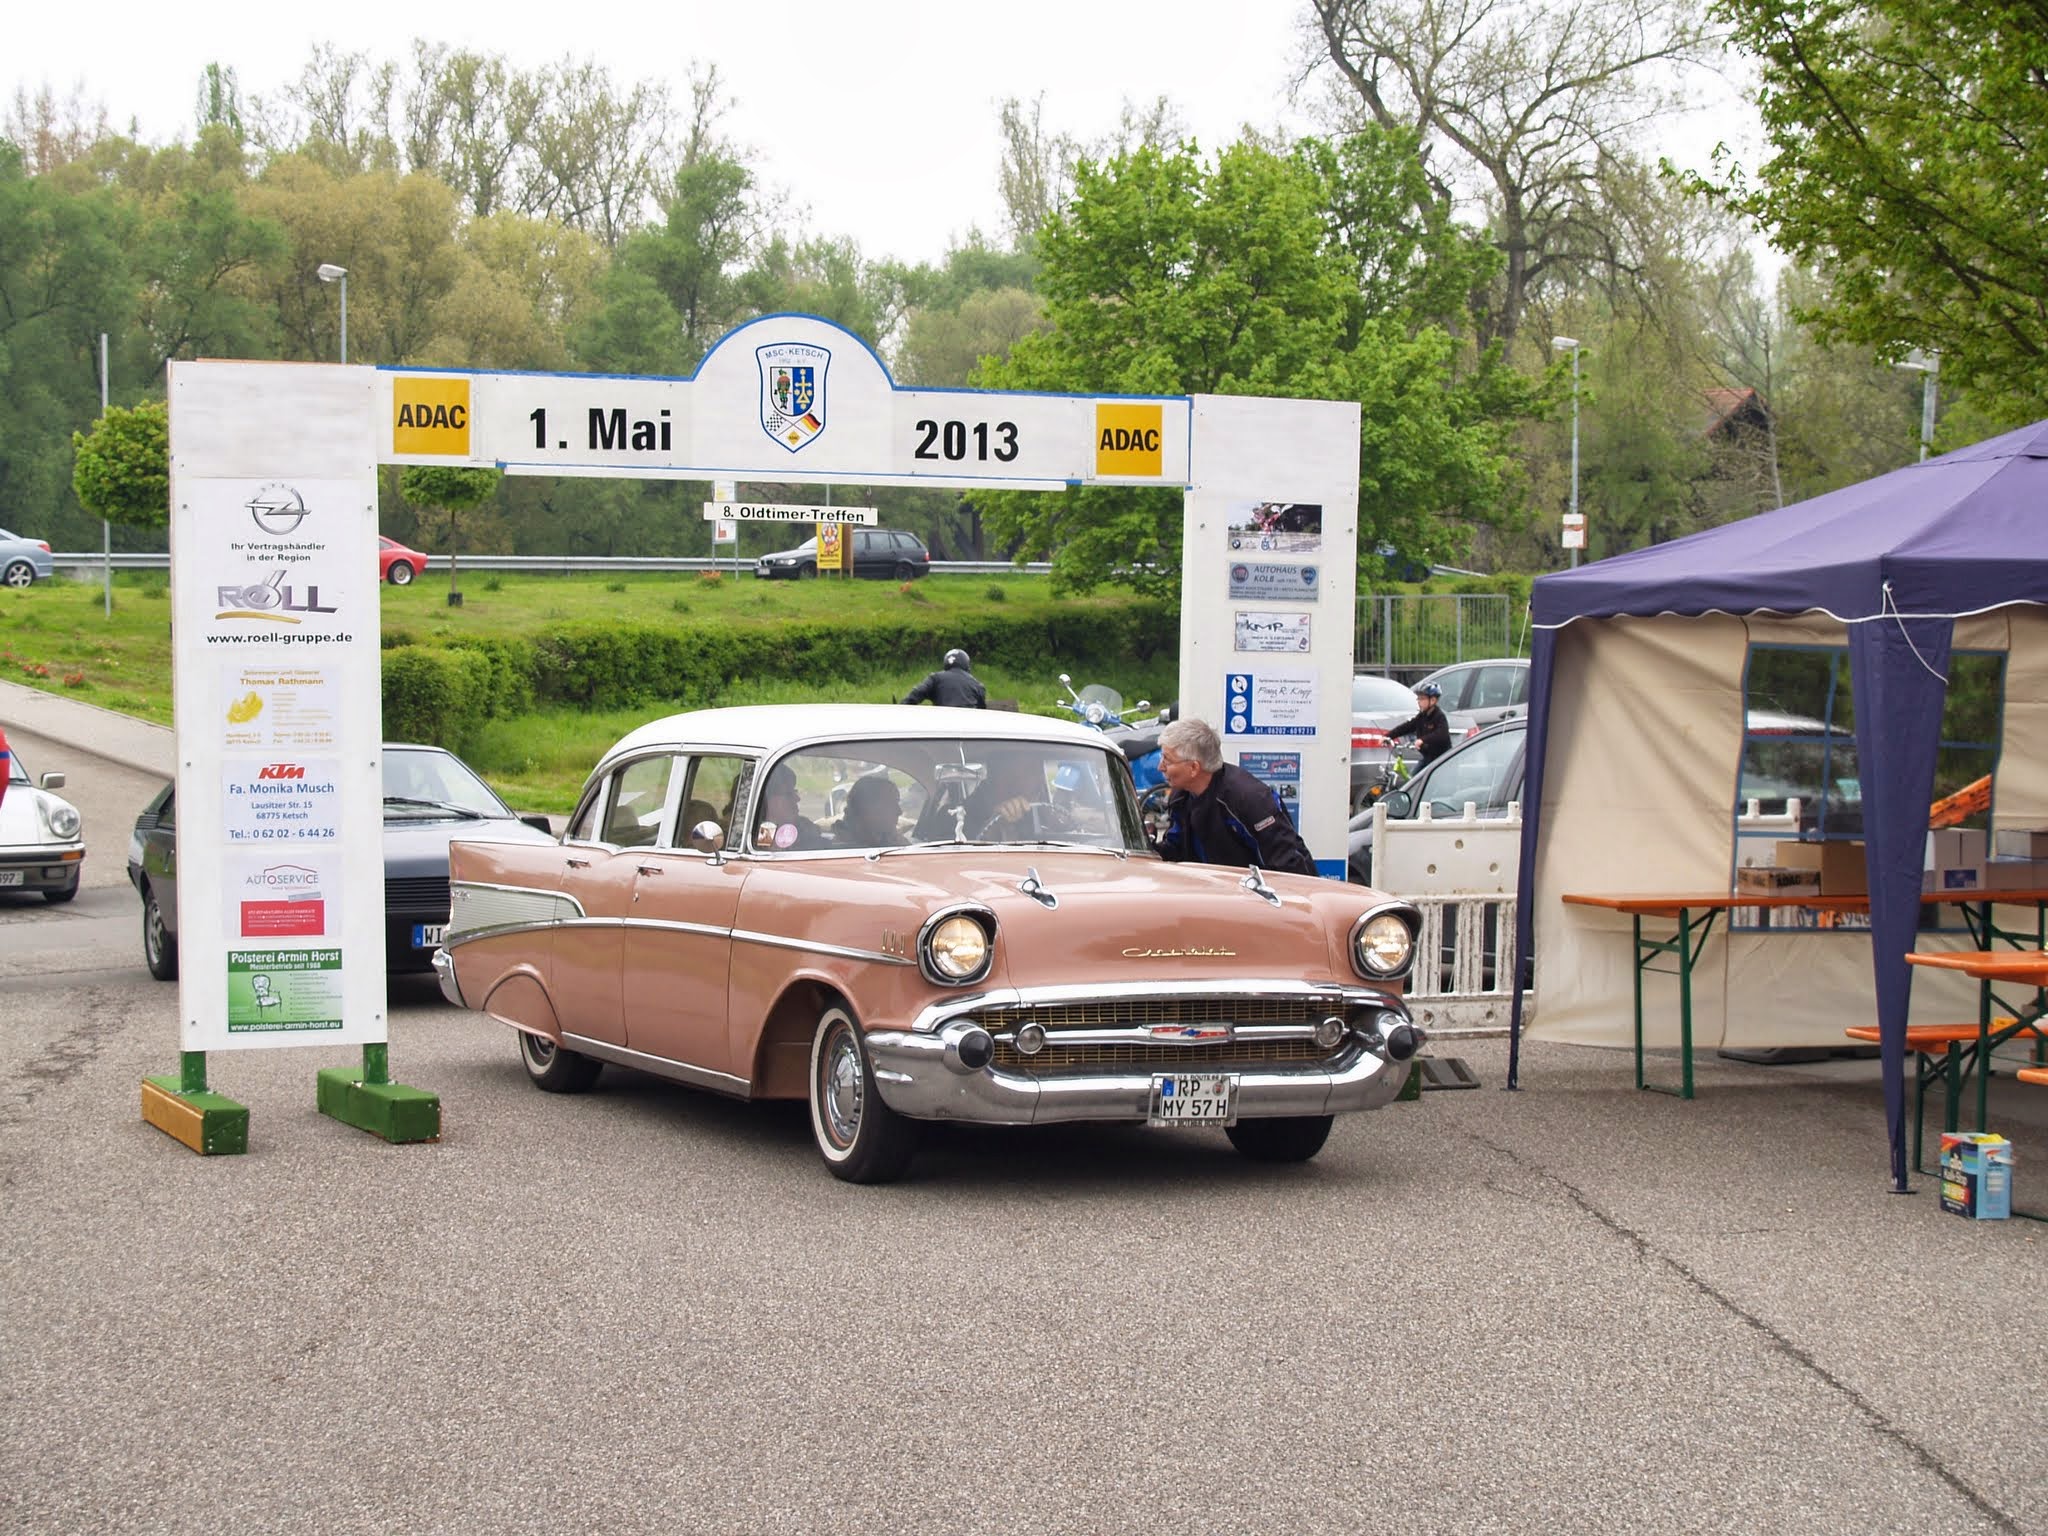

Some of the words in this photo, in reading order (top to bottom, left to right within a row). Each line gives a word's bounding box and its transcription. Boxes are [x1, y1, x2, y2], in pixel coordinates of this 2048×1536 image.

[397, 404, 466, 429] ADAC
[588, 408, 672, 451] Mai
[914, 419, 1019, 462] 2013
[1100, 428, 1159, 452] ADAC
[723, 505, 734, 518] 8.
[740, 506, 865, 522] Oldtimer-Treffen
[277, 554, 311, 562] Region
[1254, 566, 1297, 575] AUTOHAUS
[207, 633, 352, 645] www.roell-gruppe.de
[240, 678, 275, 686] Thomas
[259, 764, 305, 779] KTM
[230, 785, 246, 794] Fa.
[250, 784, 293, 794] Monika
[297, 783, 335, 793] Musch
[252, 802, 286, 810] Lausitzer
[288, 801, 301, 809] Str.
[303, 801, 313, 809] 15
[262, 829, 274, 838] 62
[277, 829, 289, 838] 02
[307, 829, 320, 837] 44
[322, 828, 335, 837] 26
[246, 874, 319, 885] AUTOSERVICE
[231, 952, 275, 964] Polsterei
[278, 951, 308, 962] Armin
[311, 950, 339, 961] Horst
[231, 1021, 340, 1031] www.polsterei-armin-horst.eu
[1178, 1080, 1200, 1097] RP
[1163, 1100, 1185, 1116] MY
[1191, 1099, 1212, 1116] 57
[1216, 1099, 1227, 1116] H
